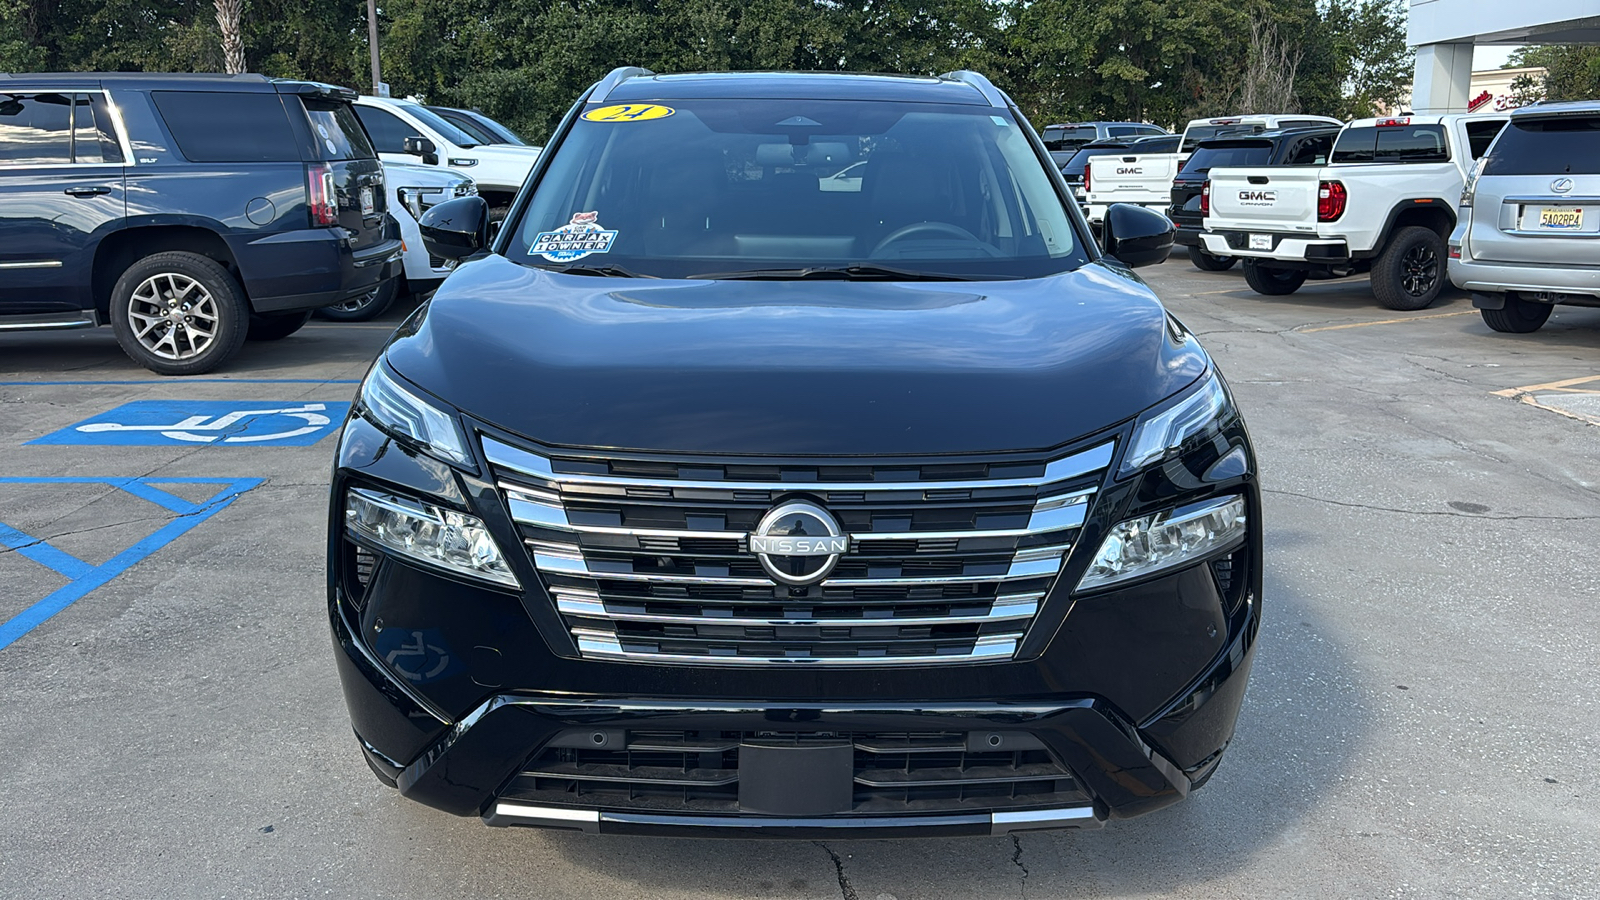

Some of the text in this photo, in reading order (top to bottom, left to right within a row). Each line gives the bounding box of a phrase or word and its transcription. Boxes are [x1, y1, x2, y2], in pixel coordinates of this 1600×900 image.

[600, 106, 656, 121] 24
[1116, 167, 1143, 175] GMC
[1239, 191, 1276, 201] GMC
[1542, 213, 1580, 226] 5A02RP4
[539, 233, 611, 243] CARFAX
[546, 241, 609, 251] OWNER
[752, 539, 845, 553] NISSAN
